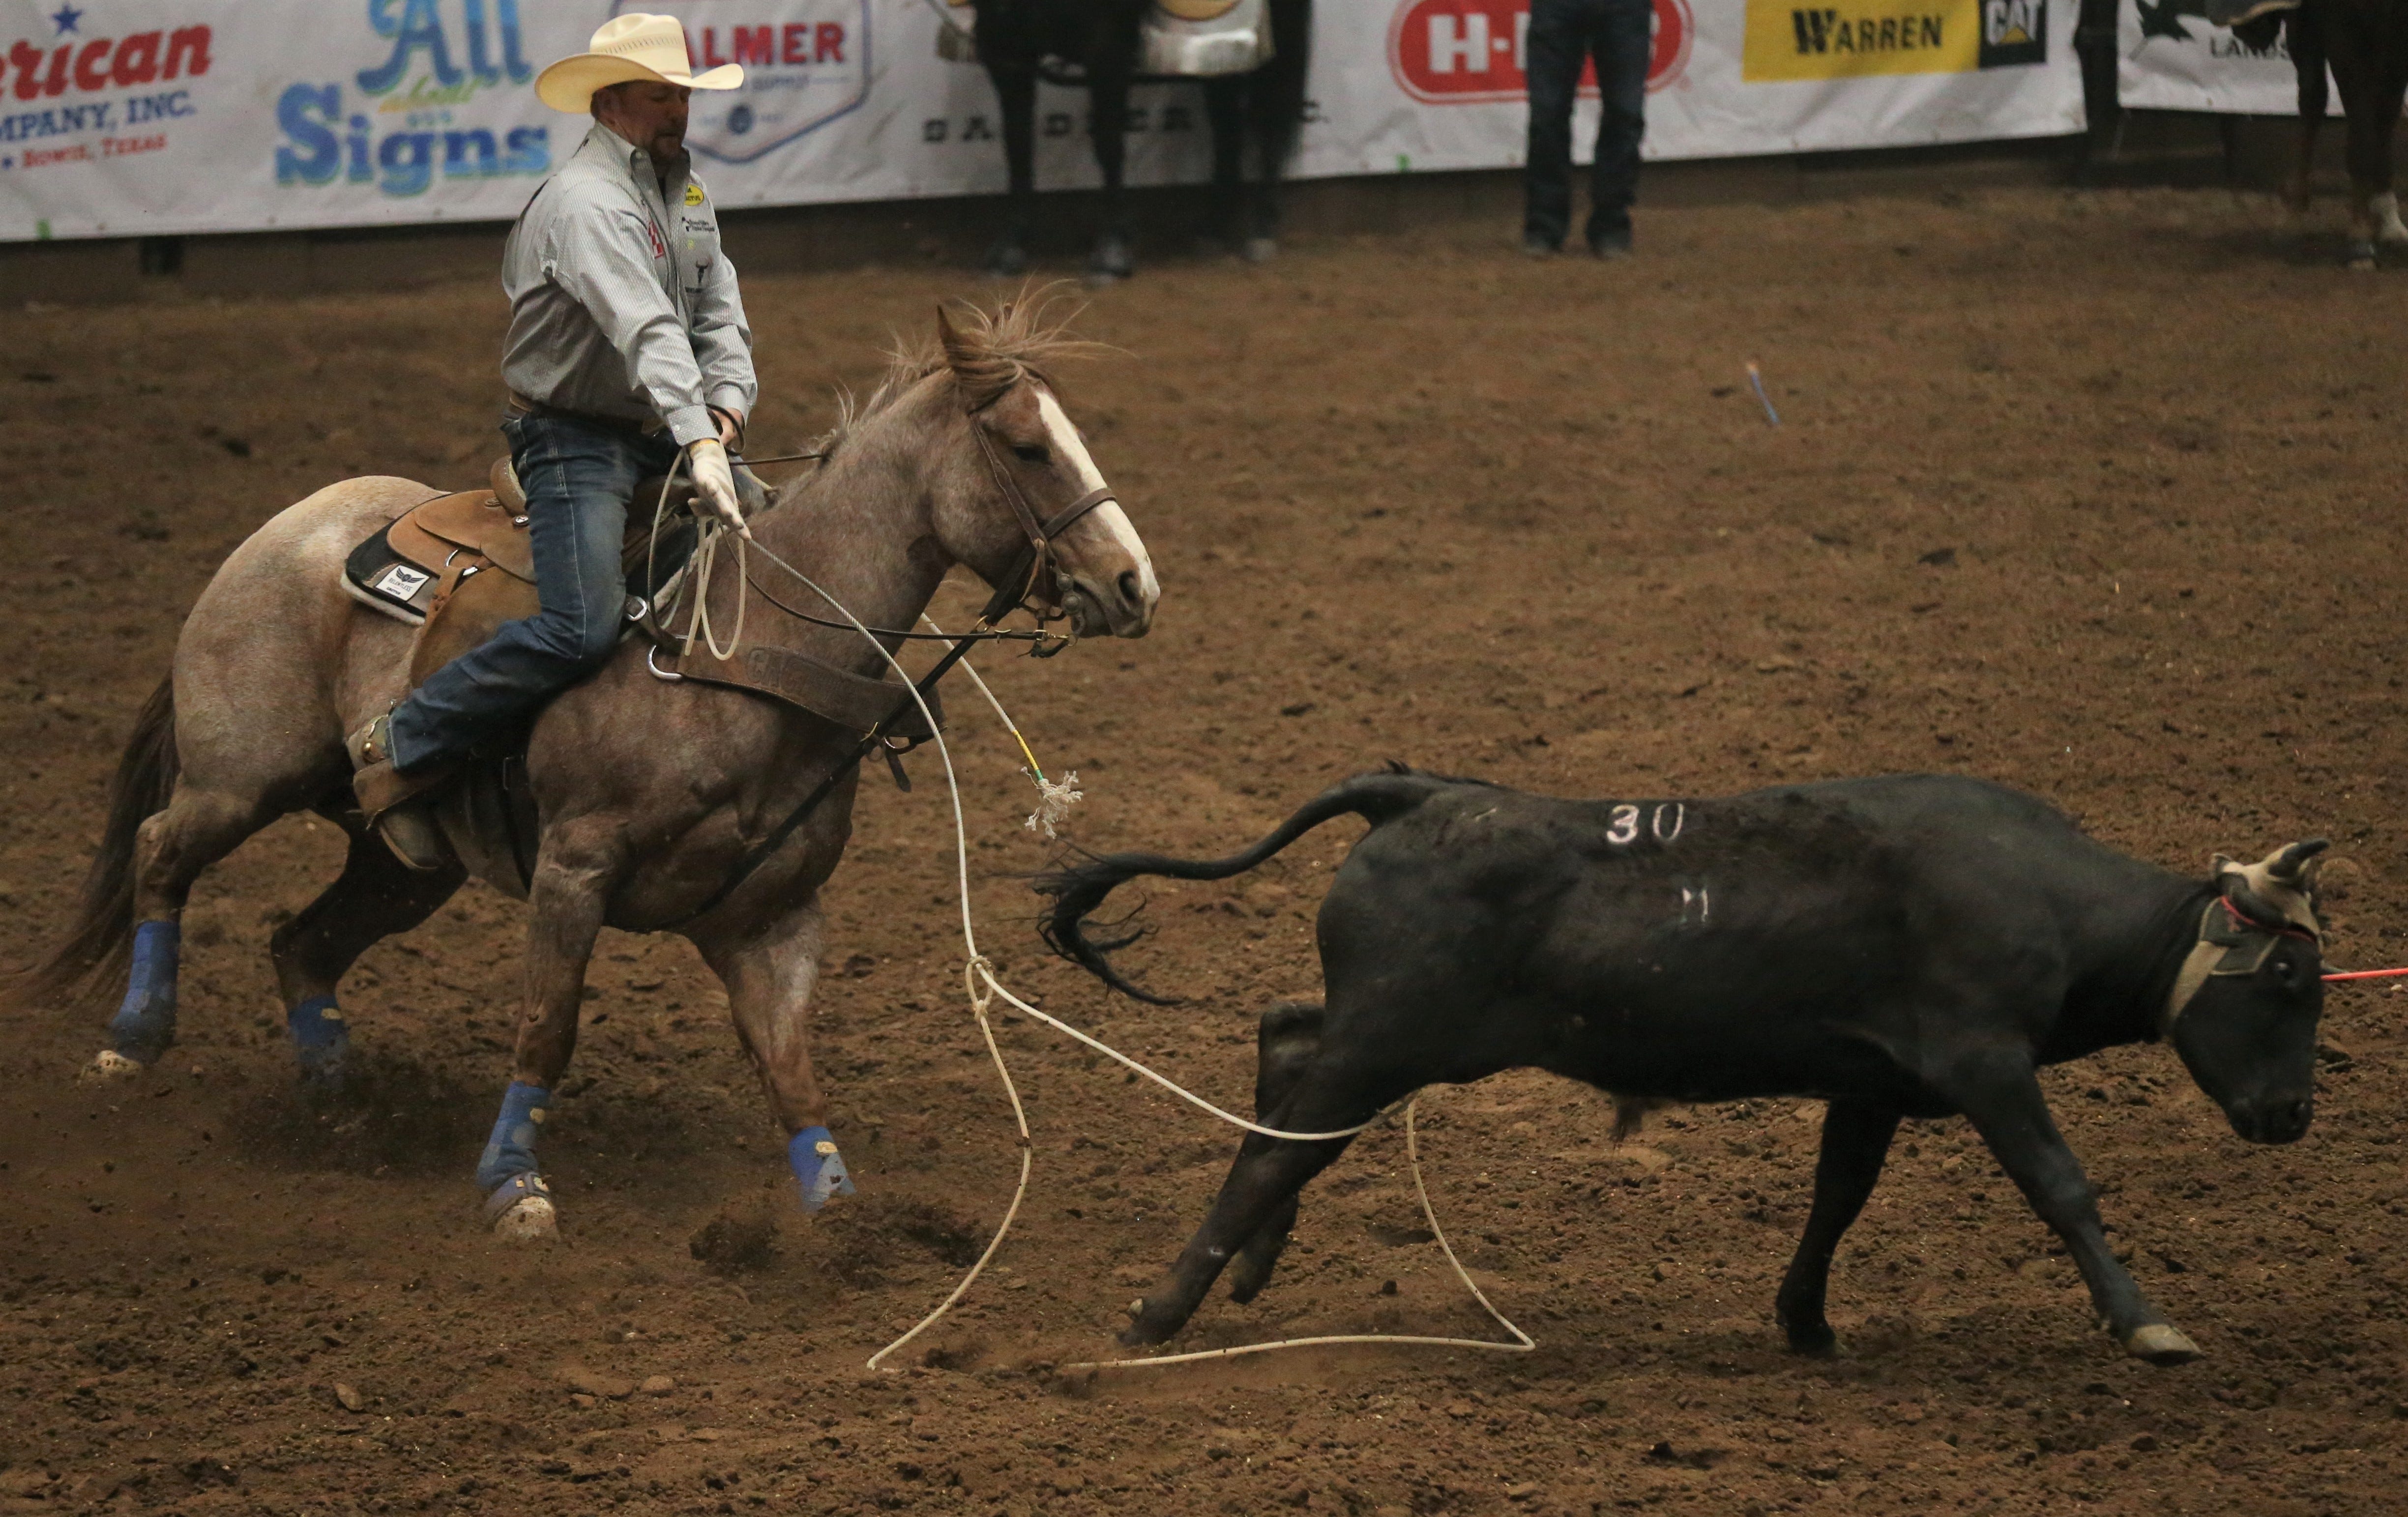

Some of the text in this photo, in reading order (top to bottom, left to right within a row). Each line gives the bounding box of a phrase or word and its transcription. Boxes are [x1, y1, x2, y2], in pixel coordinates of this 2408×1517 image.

[1791, 9, 1943, 54] WARREN
[1985, 0, 2041, 45] CAT
[0, 24, 212, 101] rican
[356, 0, 533, 96] All
[127, 90, 196, 124] INC.
[275, 82, 551, 199] Signs
[1606, 803, 1684, 844] 30
